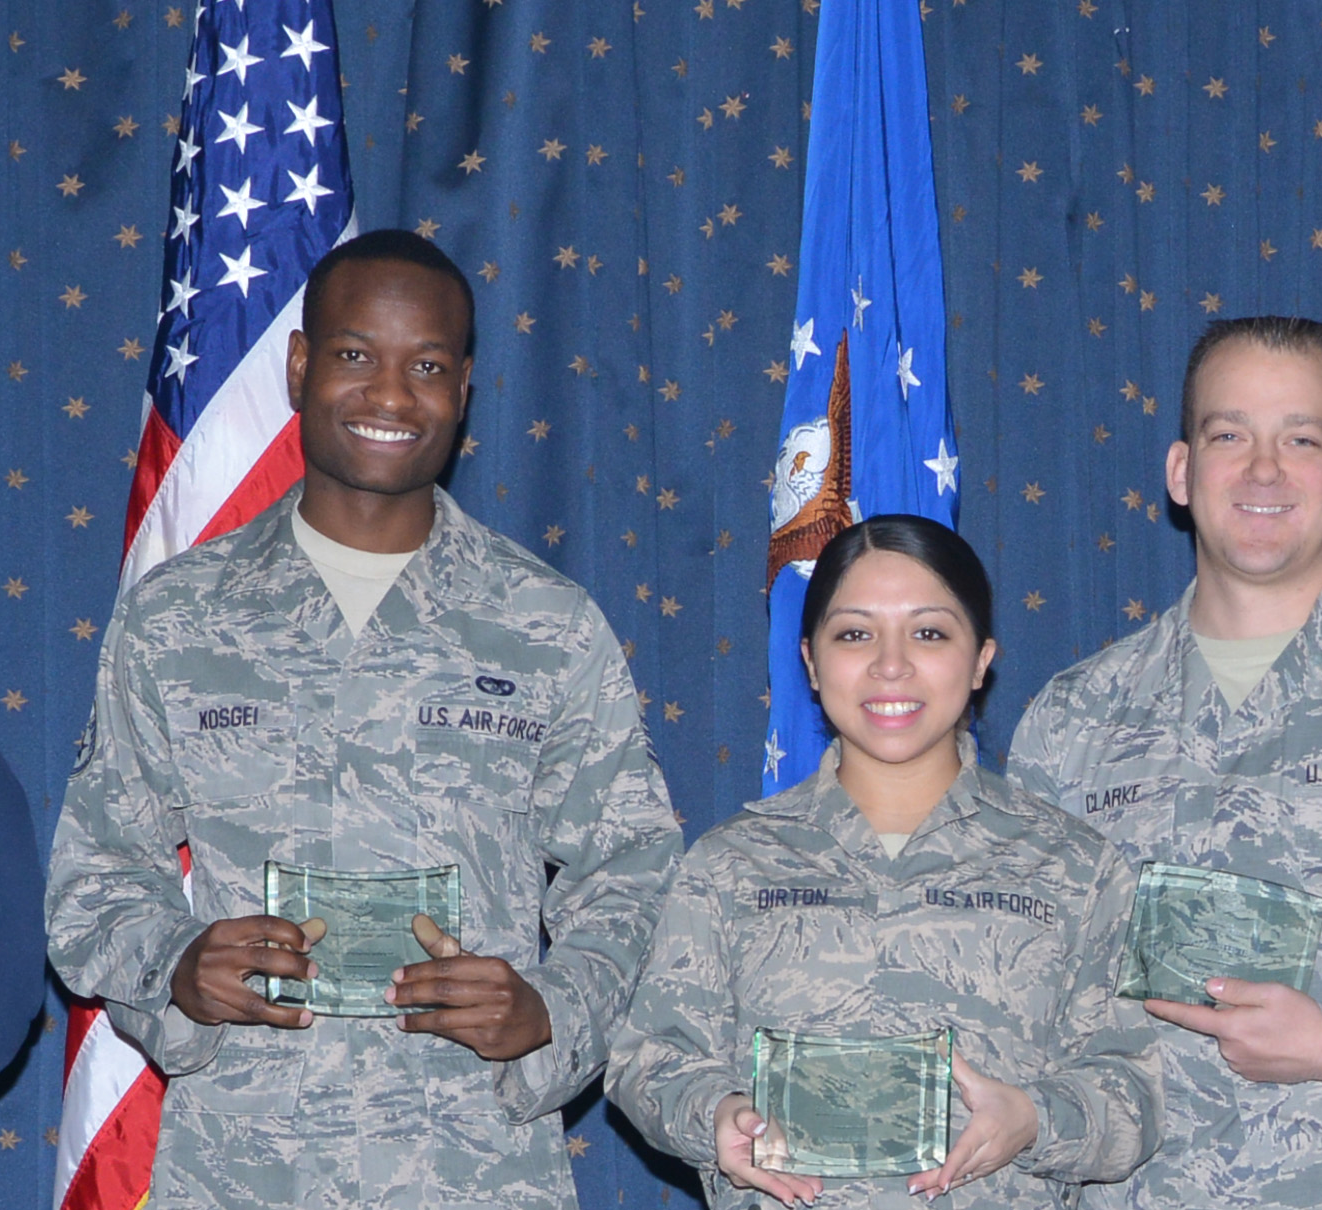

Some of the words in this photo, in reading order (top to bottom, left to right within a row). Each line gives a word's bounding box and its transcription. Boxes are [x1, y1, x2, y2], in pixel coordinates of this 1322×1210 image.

[198, 705, 259, 731] KOSGEI
[417, 705, 452, 728] U.S.
[458, 708, 494, 733] AIR
[496, 714, 548, 744] FORCE
[1085, 783, 1142, 814] CLARKE
[758, 888, 829, 910] DIRTON
[925, 888, 960, 908] U.S.
[963, 891, 994, 910] AIR
[998, 892, 1056, 925] FORCE
